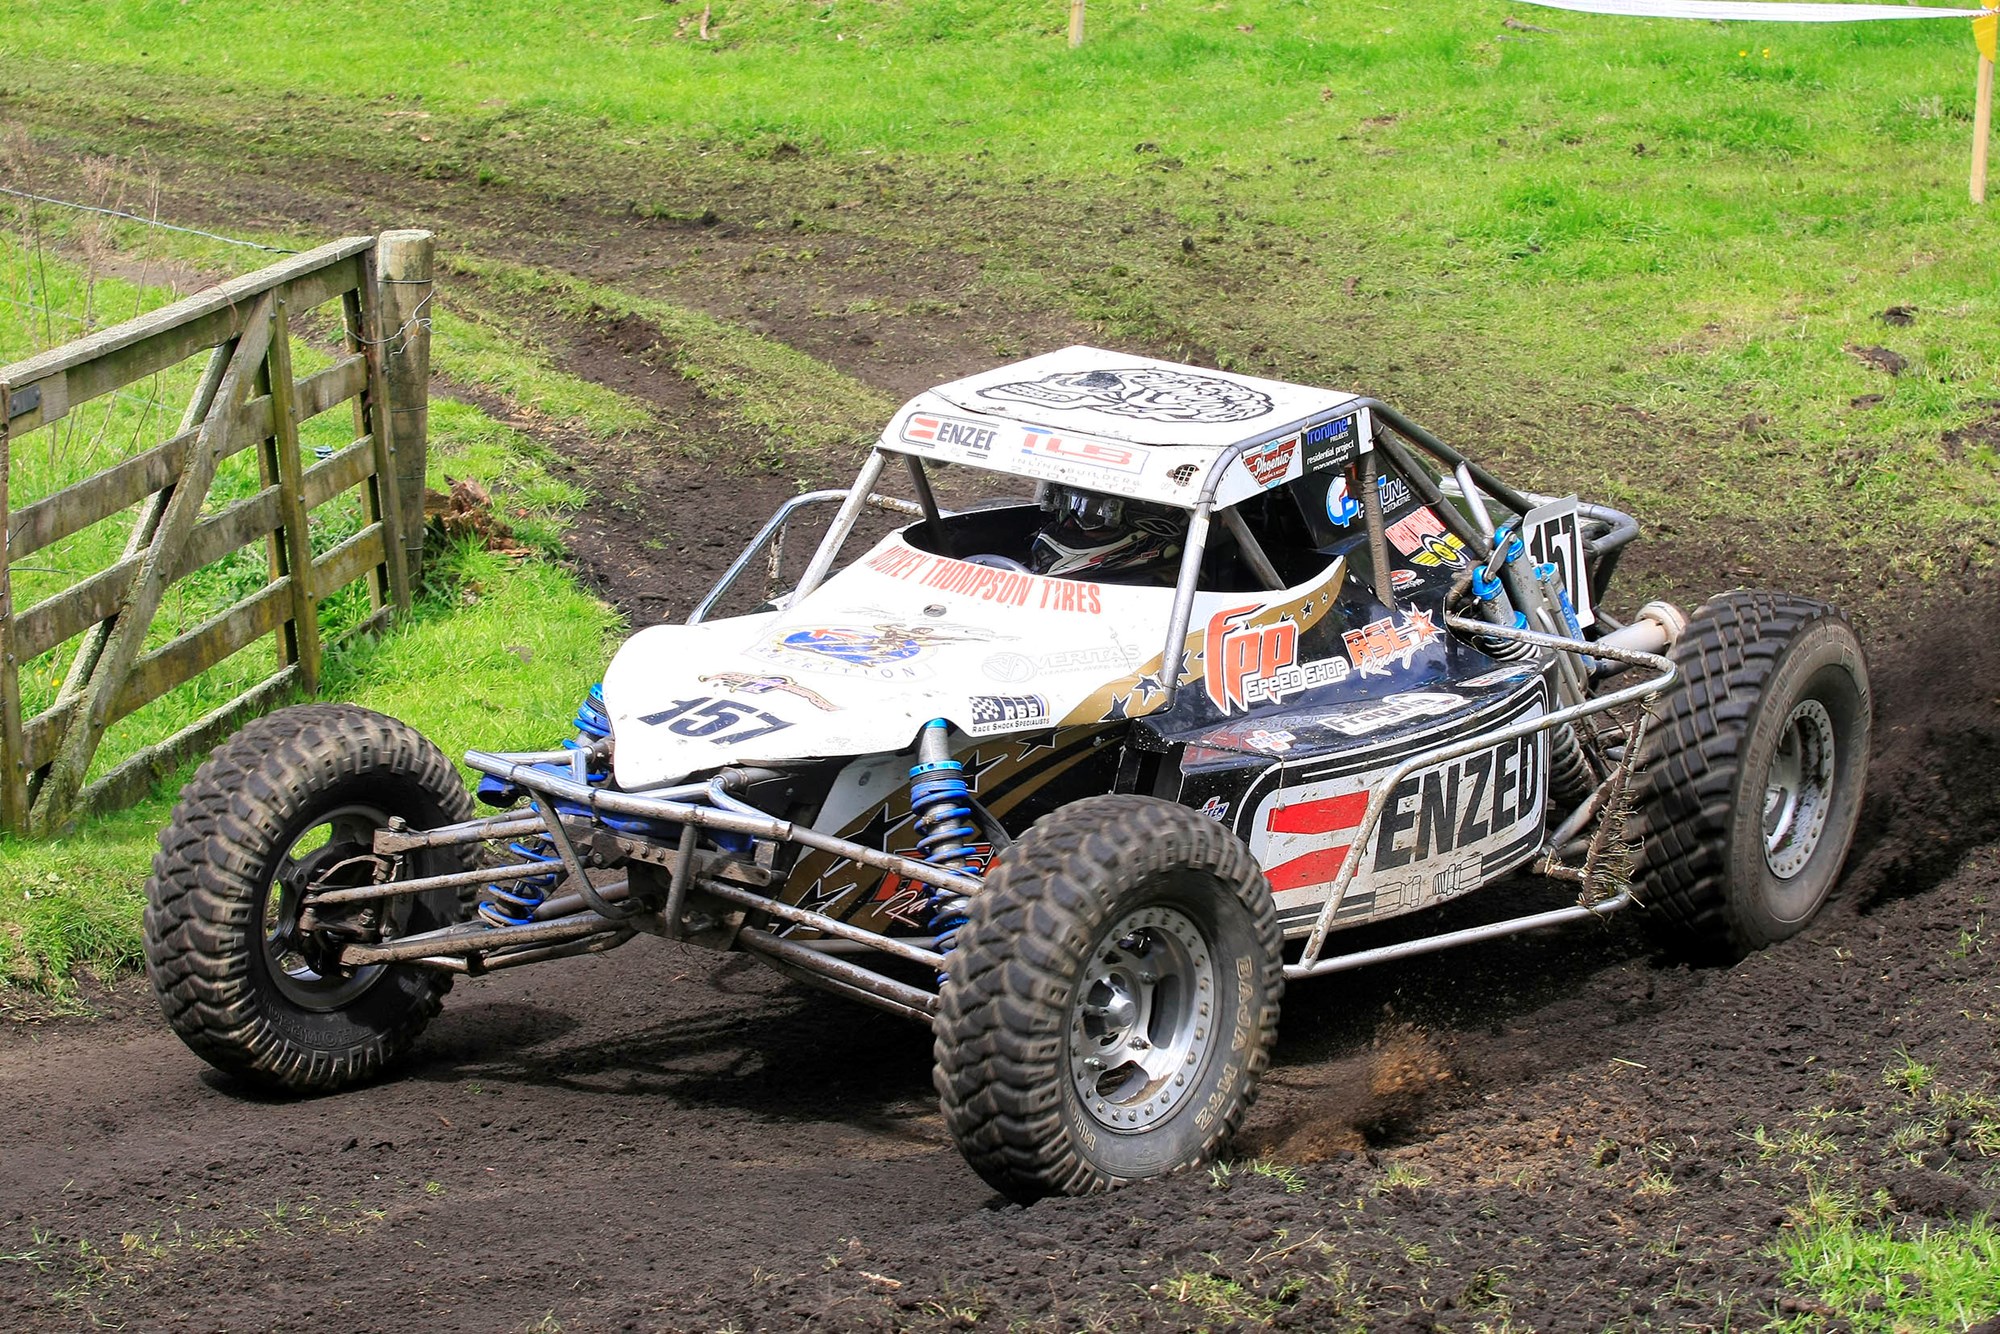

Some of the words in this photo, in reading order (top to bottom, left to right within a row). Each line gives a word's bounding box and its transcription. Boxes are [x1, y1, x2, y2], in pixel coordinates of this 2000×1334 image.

[1306, 447, 1334, 465] residential
[1336, 440, 1354, 457] project
[864, 545, 932, 580] MICKEY
[919, 558, 1035, 606] THOMPSON
[1039, 578, 1102, 614] TIRES
[1036, 645, 1141, 669] VERITAS
[1305, 662, 1348, 685] SHOP
[636, 696, 798, 746] 157
[1004, 704, 1040, 720] RSS
[1324, 698, 1434, 729] Fragola
[971, 725, 991, 734] RACE
[992, 722, 1014, 731] SHOCK
[1015, 718, 1050, 728] SPECIALISTS
[1250, 731, 1289, 747] SYSTEM
[1373, 733, 1538, 873] ENZED
[1232, 956, 1254, 1051] BAJA
